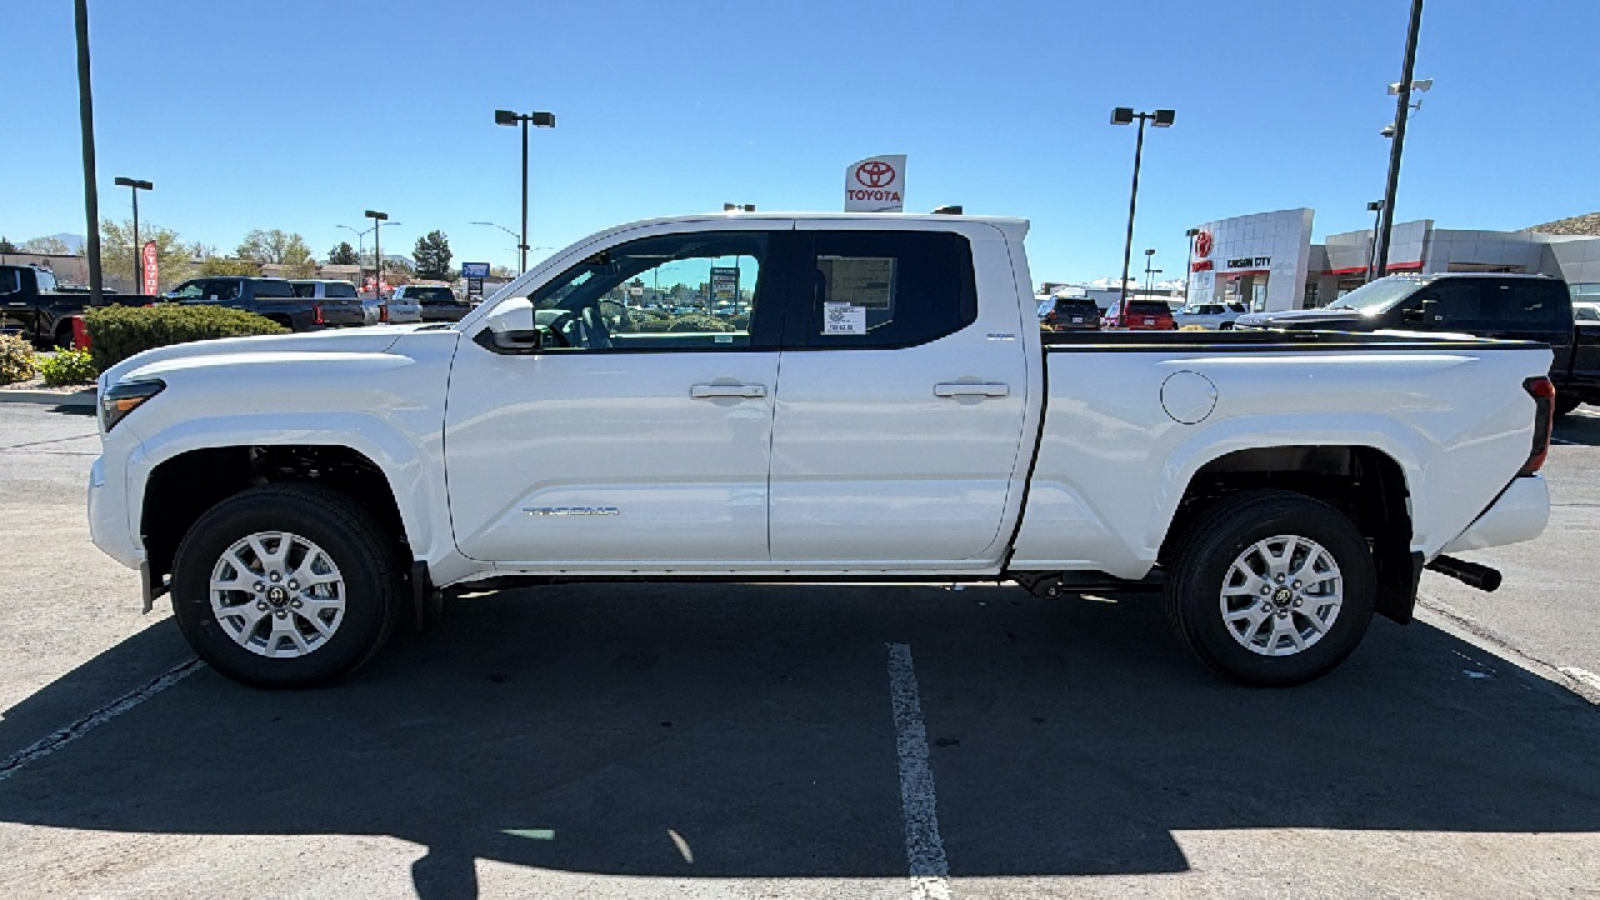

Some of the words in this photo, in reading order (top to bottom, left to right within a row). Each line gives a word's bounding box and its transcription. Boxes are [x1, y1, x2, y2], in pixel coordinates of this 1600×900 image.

[847, 189, 901, 202] TOYOTA
[1227, 259, 1253, 268] CARSON
[1255, 256, 1271, 266] CITY
[146, 255, 156, 295] TOYOT
